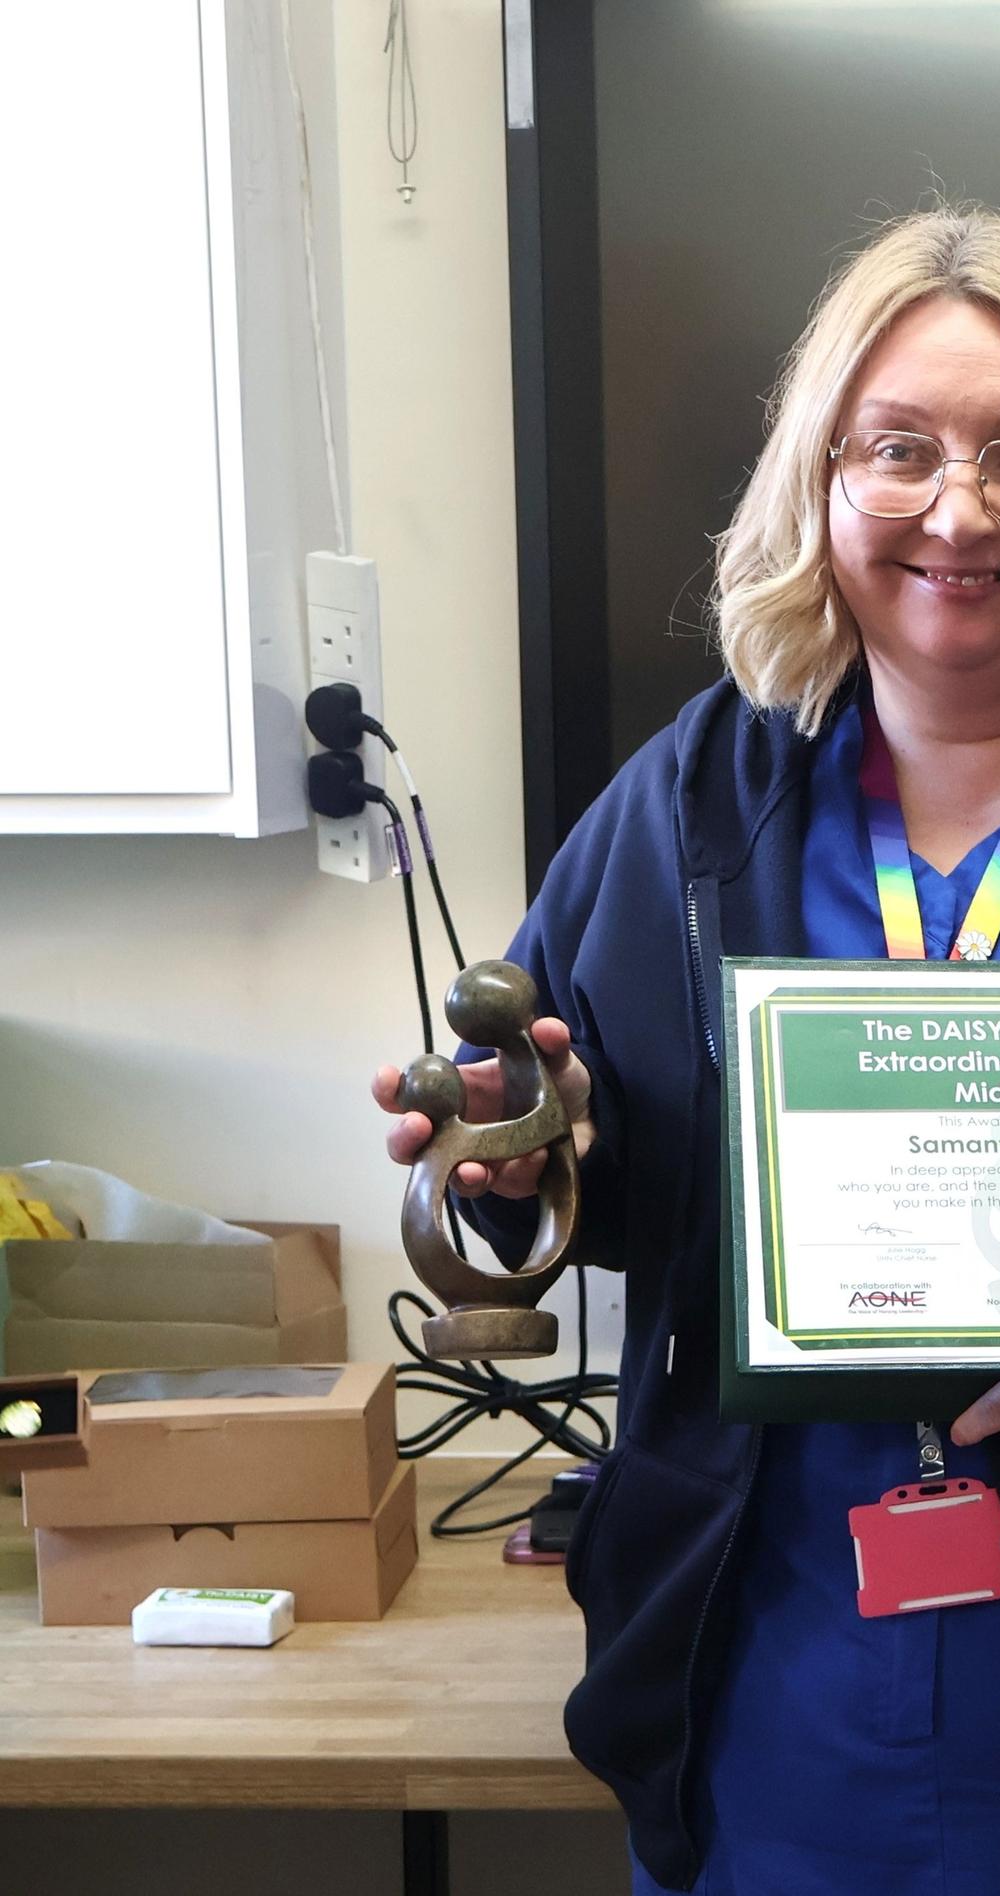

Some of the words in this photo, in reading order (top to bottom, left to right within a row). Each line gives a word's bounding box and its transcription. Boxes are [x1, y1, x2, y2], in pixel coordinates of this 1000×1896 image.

[863, 1020, 912, 1040] The
[939, 1116, 962, 1127] This
[891, 1165, 903, 1175] In
[908, 1164, 947, 1177] deep
[838, 1182, 869, 1192] who
[875, 1183, 901, 1194] you
[939, 1181, 968, 1192] and
[973, 1180, 997, 1191] the
[893, 1199, 919, 1210] you
[925, 1196, 965, 1208] make
[971, 1196, 982, 1208] in
[848, 1291, 926, 1307] AONE
